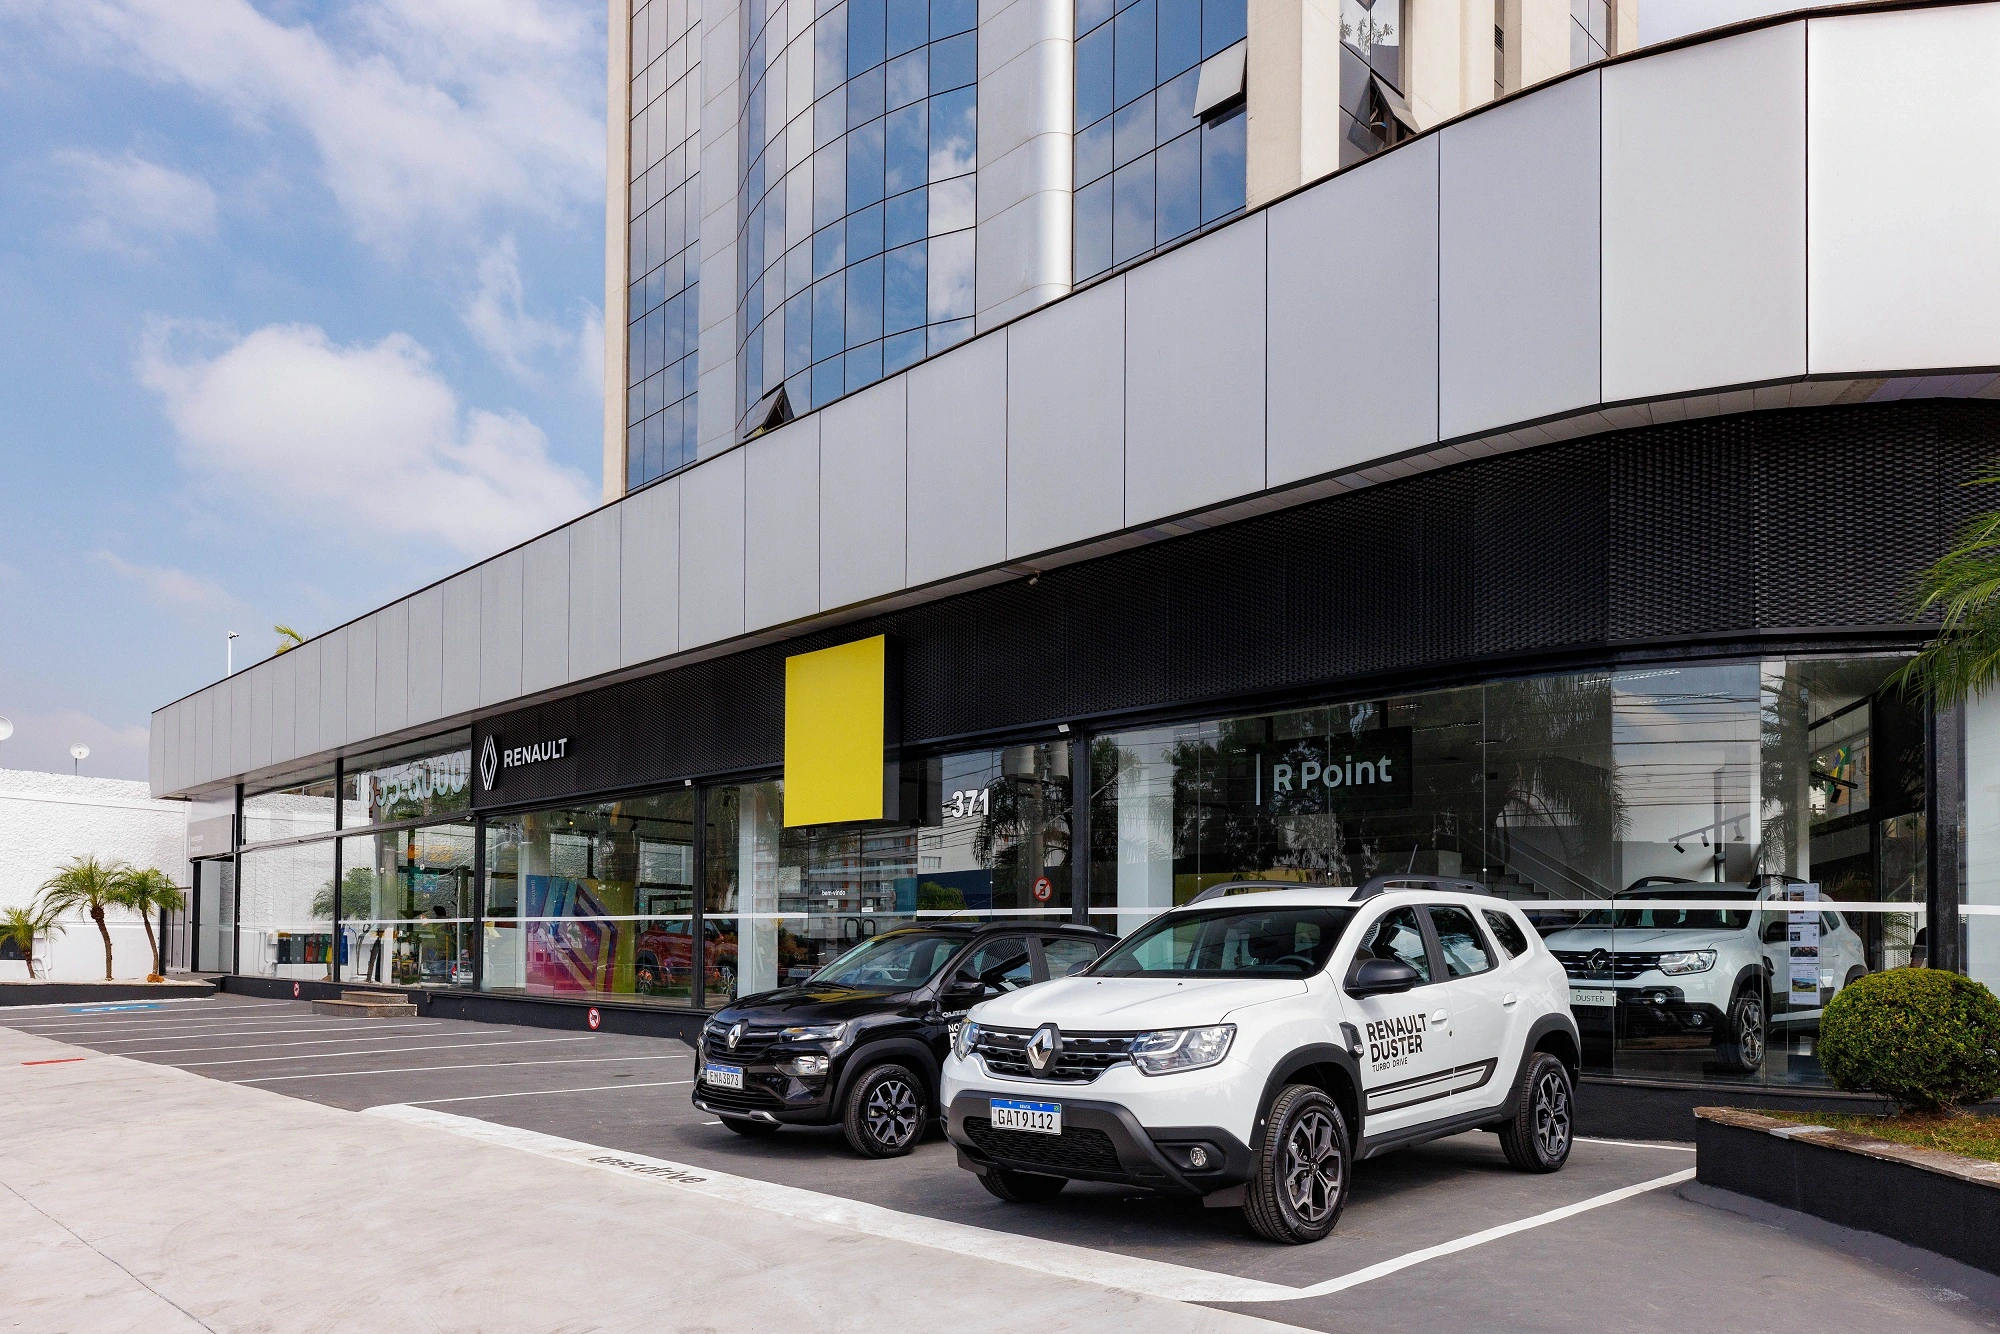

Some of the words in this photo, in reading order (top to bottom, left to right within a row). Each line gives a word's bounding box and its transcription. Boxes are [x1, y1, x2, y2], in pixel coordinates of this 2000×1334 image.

[503, 737, 568, 768] RENAULT
[1273, 763, 1293, 792] R
[1301, 755, 1393, 790] Point
[951, 788, 989, 818] 371
[1575, 994, 1605, 1003] DUSTER
[1366, 1013, 1427, 1042] RENAULT
[1370, 1034, 1423, 1063] DUSTER
[1372, 1061, 1390, 1072] TURBO
[1392, 1056, 1408, 1068] DRIVE
[998, 1109, 1054, 1130] GAT9I12
